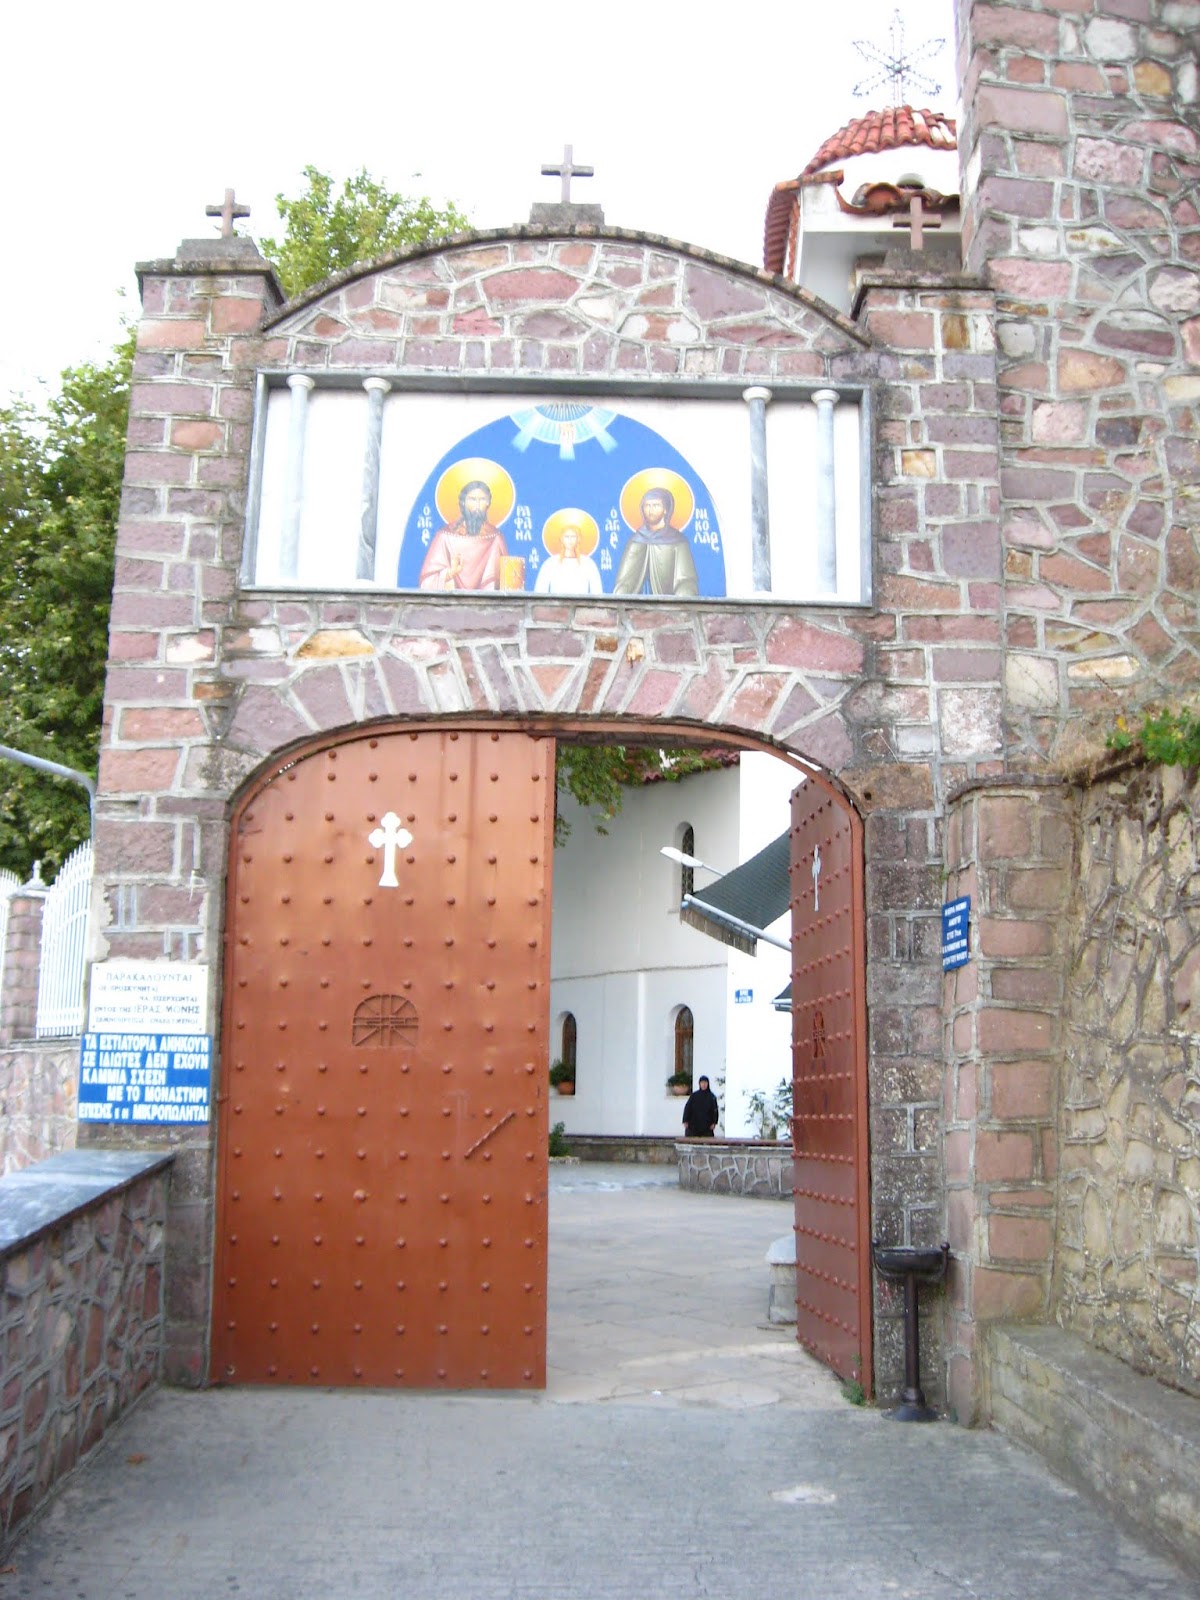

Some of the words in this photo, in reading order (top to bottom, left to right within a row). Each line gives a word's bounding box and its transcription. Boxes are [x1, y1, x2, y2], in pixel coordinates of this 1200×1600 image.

[106, 973, 192, 982] ΠΑΡΑΚΑΛΟΥΝΤΑΙ
[166, 1006, 200, 1014] ΜΟΝΗΣ
[85, 1035, 97, 1050] ΤΑ
[99, 1035, 156, 1050] ΕΣΤΙΑΤΟΡΙΑ
[160, 1036, 208, 1052] ΑΝΗΚΟΥΝ
[83, 1052, 96, 1067] ΣΕ
[99, 1052, 141, 1068] ΙΔΙΩΤΕΣ
[146, 1053, 168, 1068] ΔΕΝ
[174, 1054, 208, 1069] ΕΧΟΥΝ
[82, 1068, 126, 1084] ΚΑΜΜΙΑ
[131, 1070, 166, 1085] ΣΧΕΣΗ
[107, 1086, 123, 1101] ΜΕ
[127, 1086, 140, 1101] ΤΟ
[145, 1087, 206, 1102] ΜΟΝΑΣΤΗΡΙ
[133, 1104, 208, 1121] ΜΙΚΡΟΠΩΛΗΤΑΙ
